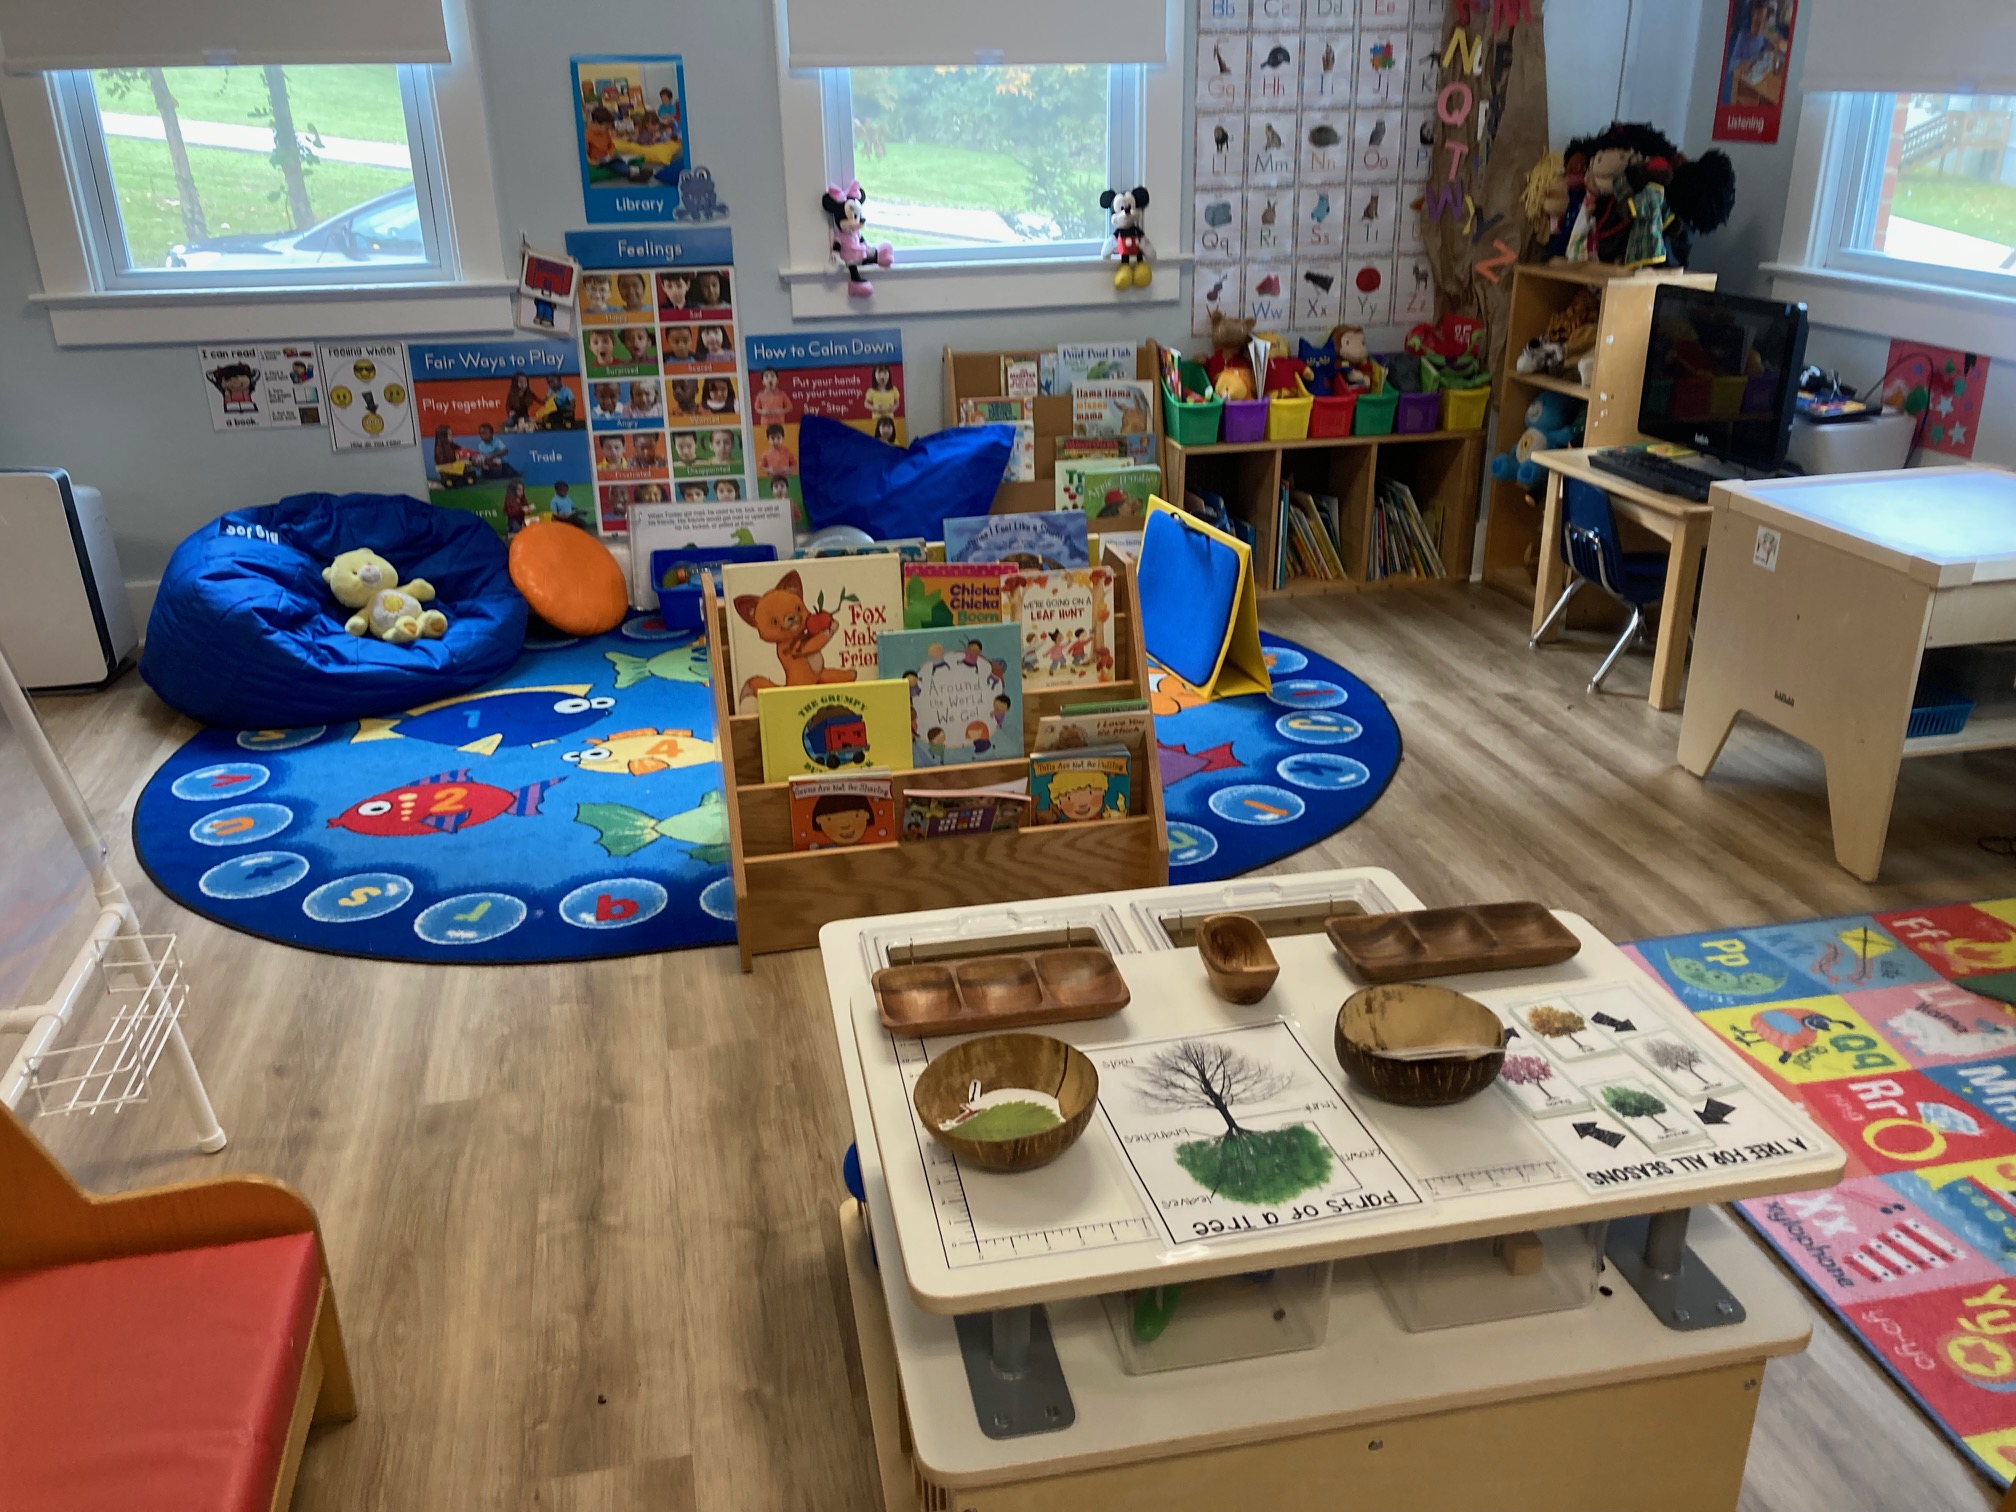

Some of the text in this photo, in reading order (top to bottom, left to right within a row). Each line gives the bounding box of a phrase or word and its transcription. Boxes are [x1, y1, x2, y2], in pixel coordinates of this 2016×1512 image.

[1442, 26, 1482, 75] N
[1262, 75, 1285, 97] Hh
[1437, 81, 1473, 127] Q
[1727, 113, 1765, 132] Listening
[1255, 153, 1288, 174] Mm
[1312, 151, 1335, 172] Nn
[1364, 150, 1389, 170] Oo
[1445, 140, 1469, 182] T
[615, 196, 664, 214] Library
[1425, 179, 1463, 224] W
[1202, 230, 1229, 256] Qq
[1311, 225, 1330, 246] Ss
[618, 239, 683, 262] Feelings
[605, 312, 628, 323] Happy
[1252, 301, 1282, 320] Ww
[1307, 298, 1327, 318] Xx
[1358, 296, 1377, 322] Yy
[212, 351, 229, 359] can
[231, 348, 256, 358] read
[754, 338, 896, 361] How to Calm Down
[424, 349, 565, 373] Fair Ways to Play
[606, 366, 639, 376] Surprised
[792, 374, 861, 391] Put your hands
[423, 395, 501, 414] Play together
[792, 391, 804, 399] on
[806, 390, 827, 402] your
[803, 403, 820, 416] Say
[1076, 412, 1103, 421] mama
[617, 419, 638, 429] Angry
[529, 450, 563, 463] Trade
[687, 465, 731, 476] Disappointed
[995, 523, 1012, 535] Feel
[1014, 521, 1031, 531] Like
[950, 583, 1000, 597] Chicka
[950, 598, 999, 611] Chicka
[1044, 598, 1070, 608] GOING
[1072, 598, 1084, 607] ON
[1085, 596, 1092, 606] A
[849, 603, 887, 626] Fox
[957, 611, 999, 624] Boom
[1031, 608, 1085, 622] LEAF HUNT
[844, 626, 878, 647] Mak
[929, 676, 983, 696] Around
[798, 694, 868, 717] THE GRUMPY
[930, 693, 983, 709] the World
[463, 710, 481, 728] 1
[937, 709, 955, 724] We
[646, 739, 685, 758] 4
[1059, 761, 1071, 770] Are
[1072, 761, 1085, 769] Not
[818, 784, 831, 793] Are
[833, 783, 845, 791] Not
[429, 787, 468, 812] 2
[1892, 916, 1951, 939] Ff
[1701, 938, 1750, 967] Pp
[1829, 1033, 1896, 1070] Qq
[1101, 1056, 1135, 1070] roots
[1848, 1078, 1908, 1117] Rr
[1124, 1127, 1190, 1144] branches
[1340, 1147, 1384, 1162] crown
[1585, 1137, 1806, 1186] A TREE FOR ALL SEASONS
[1161, 1193, 1213, 1211] leaves
[1262, 1209, 1283, 1226] a
[1785, 1192, 1858, 1237] Xx
[1192, 1211, 1258, 1238] Tree
[1763, 1200, 1855, 1289] xylophone
[1958, 1284, 2016, 1336] Yy
